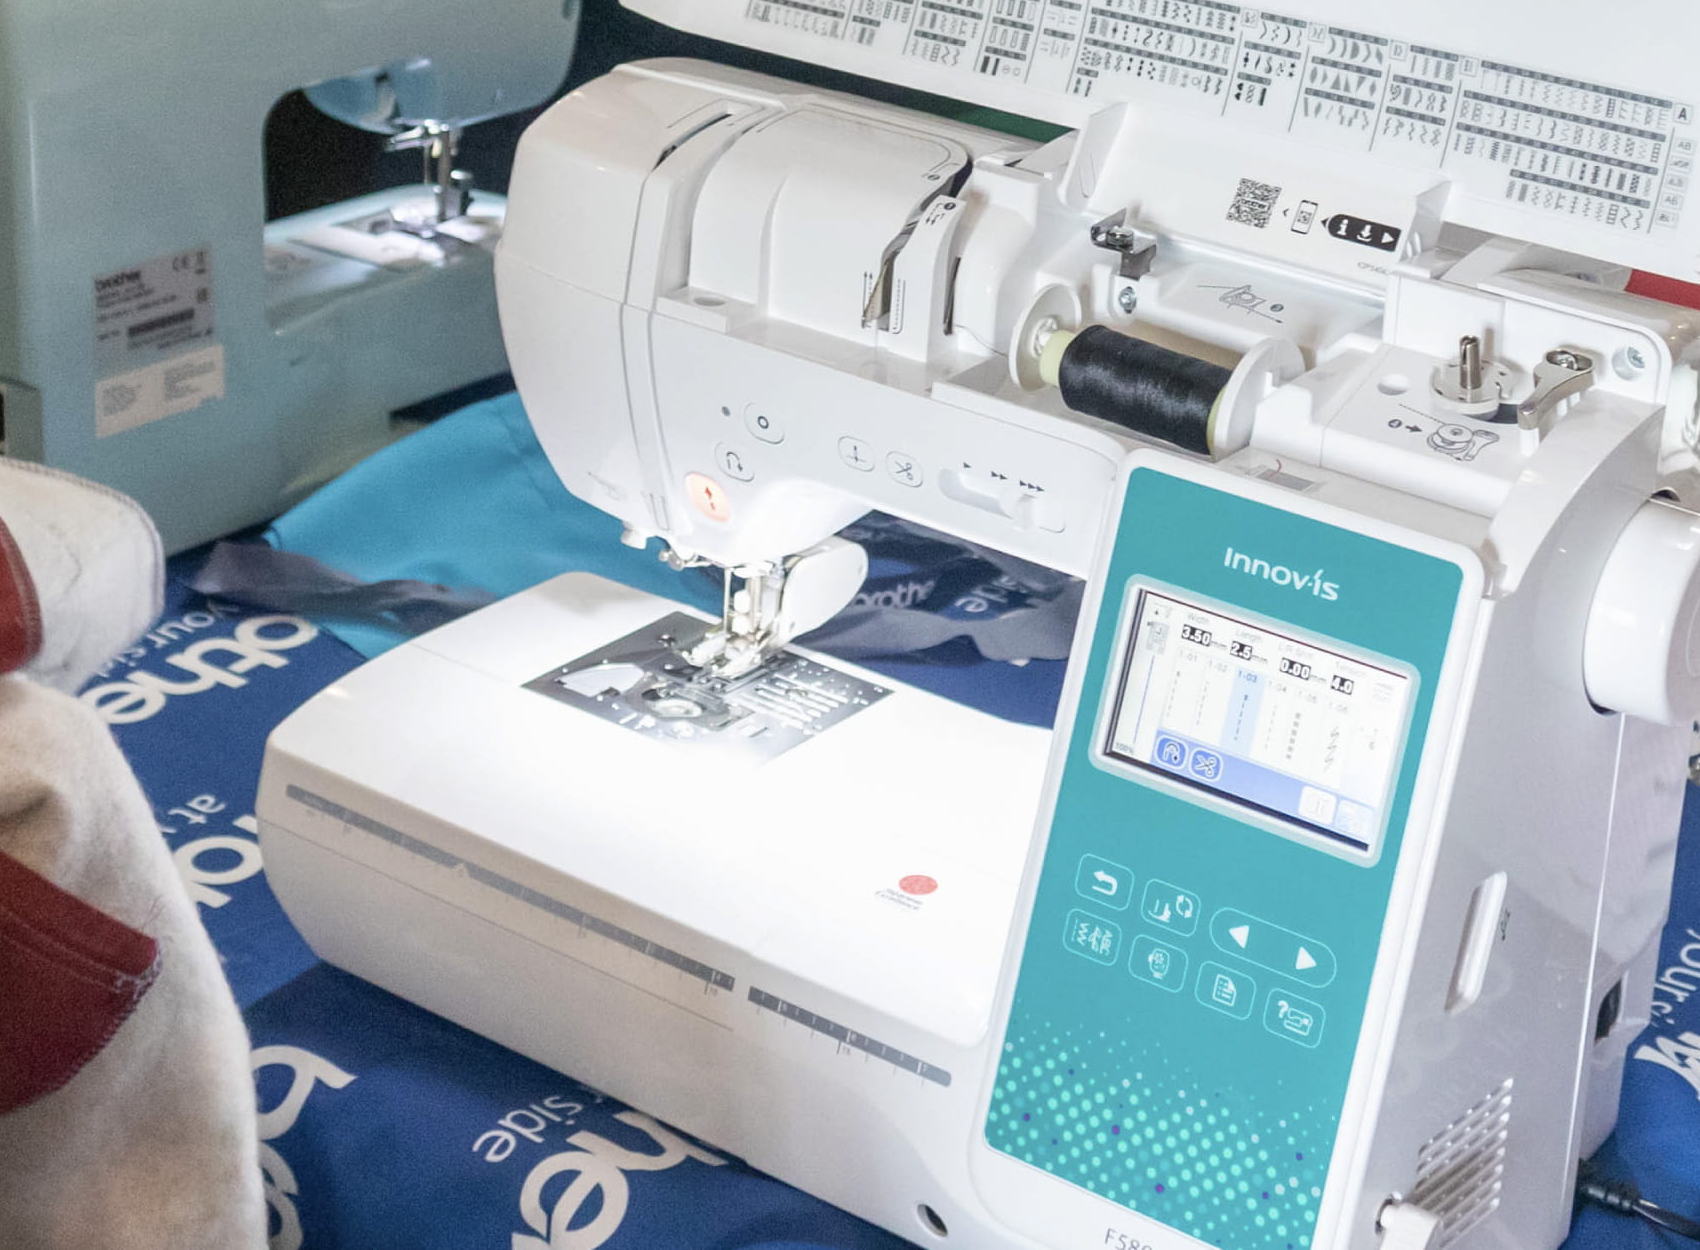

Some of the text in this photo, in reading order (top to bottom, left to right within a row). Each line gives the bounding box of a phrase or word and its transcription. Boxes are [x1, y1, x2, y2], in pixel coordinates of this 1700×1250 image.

[1182, 626, 1211, 646] 3.50
[1231, 642, 1252, 660] 2.5
[1280, 658, 1311, 680] 0.00
[1331, 675, 1354, 695] 4.0
[471, 1095, 585, 1163] side
[1104, 1227, 1153, 1250] F58
